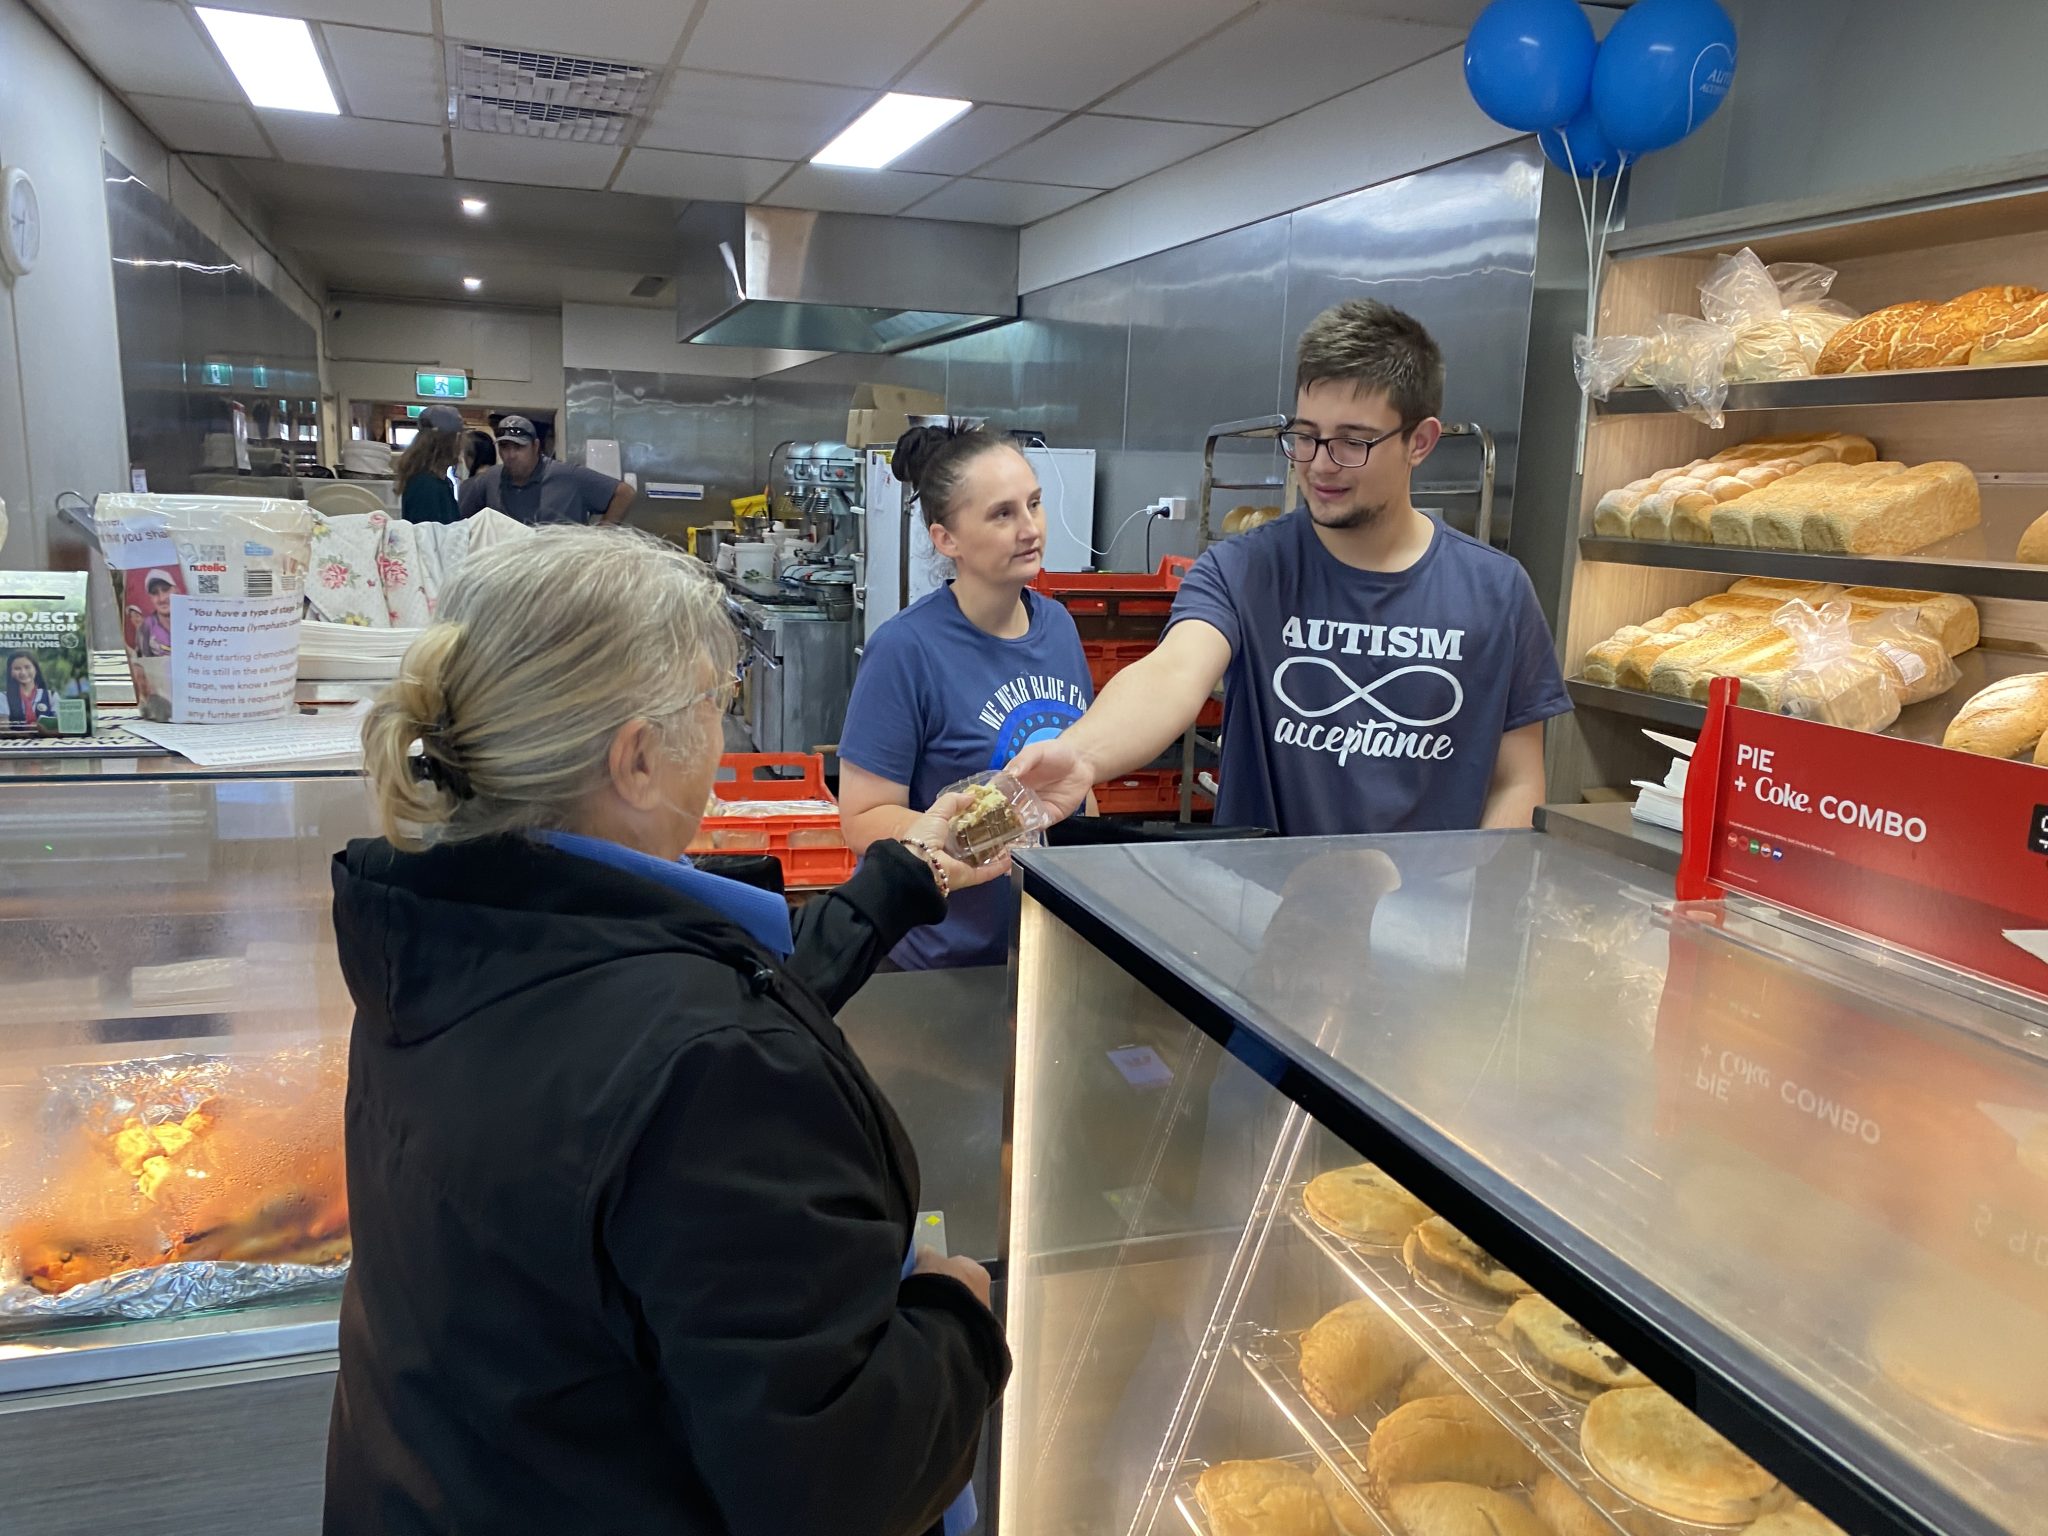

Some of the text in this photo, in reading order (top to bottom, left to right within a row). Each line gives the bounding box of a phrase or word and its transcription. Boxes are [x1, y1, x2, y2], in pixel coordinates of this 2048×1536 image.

[122, 533, 142, 544] you
[189, 563, 227, 572] nutella
[214, 609, 240, 618] have
[250, 610, 269, 618] type
[188, 622, 245, 633] Lymphoma
[1282, 615, 1465, 661] AUTISM
[187, 651, 213, 662] After
[187, 695, 236, 705] treatment
[978, 700, 1006, 731] WE
[993, 677, 1031, 713] WEAR
[1029, 675, 1065, 702] BLUE
[207, 710, 241, 719] further
[1273, 717, 1454, 767] acceptance
[1736, 744, 1775, 773] PIE
[1755, 776, 1811, 813] Coke
[1819, 795, 1927, 843] COMBO
